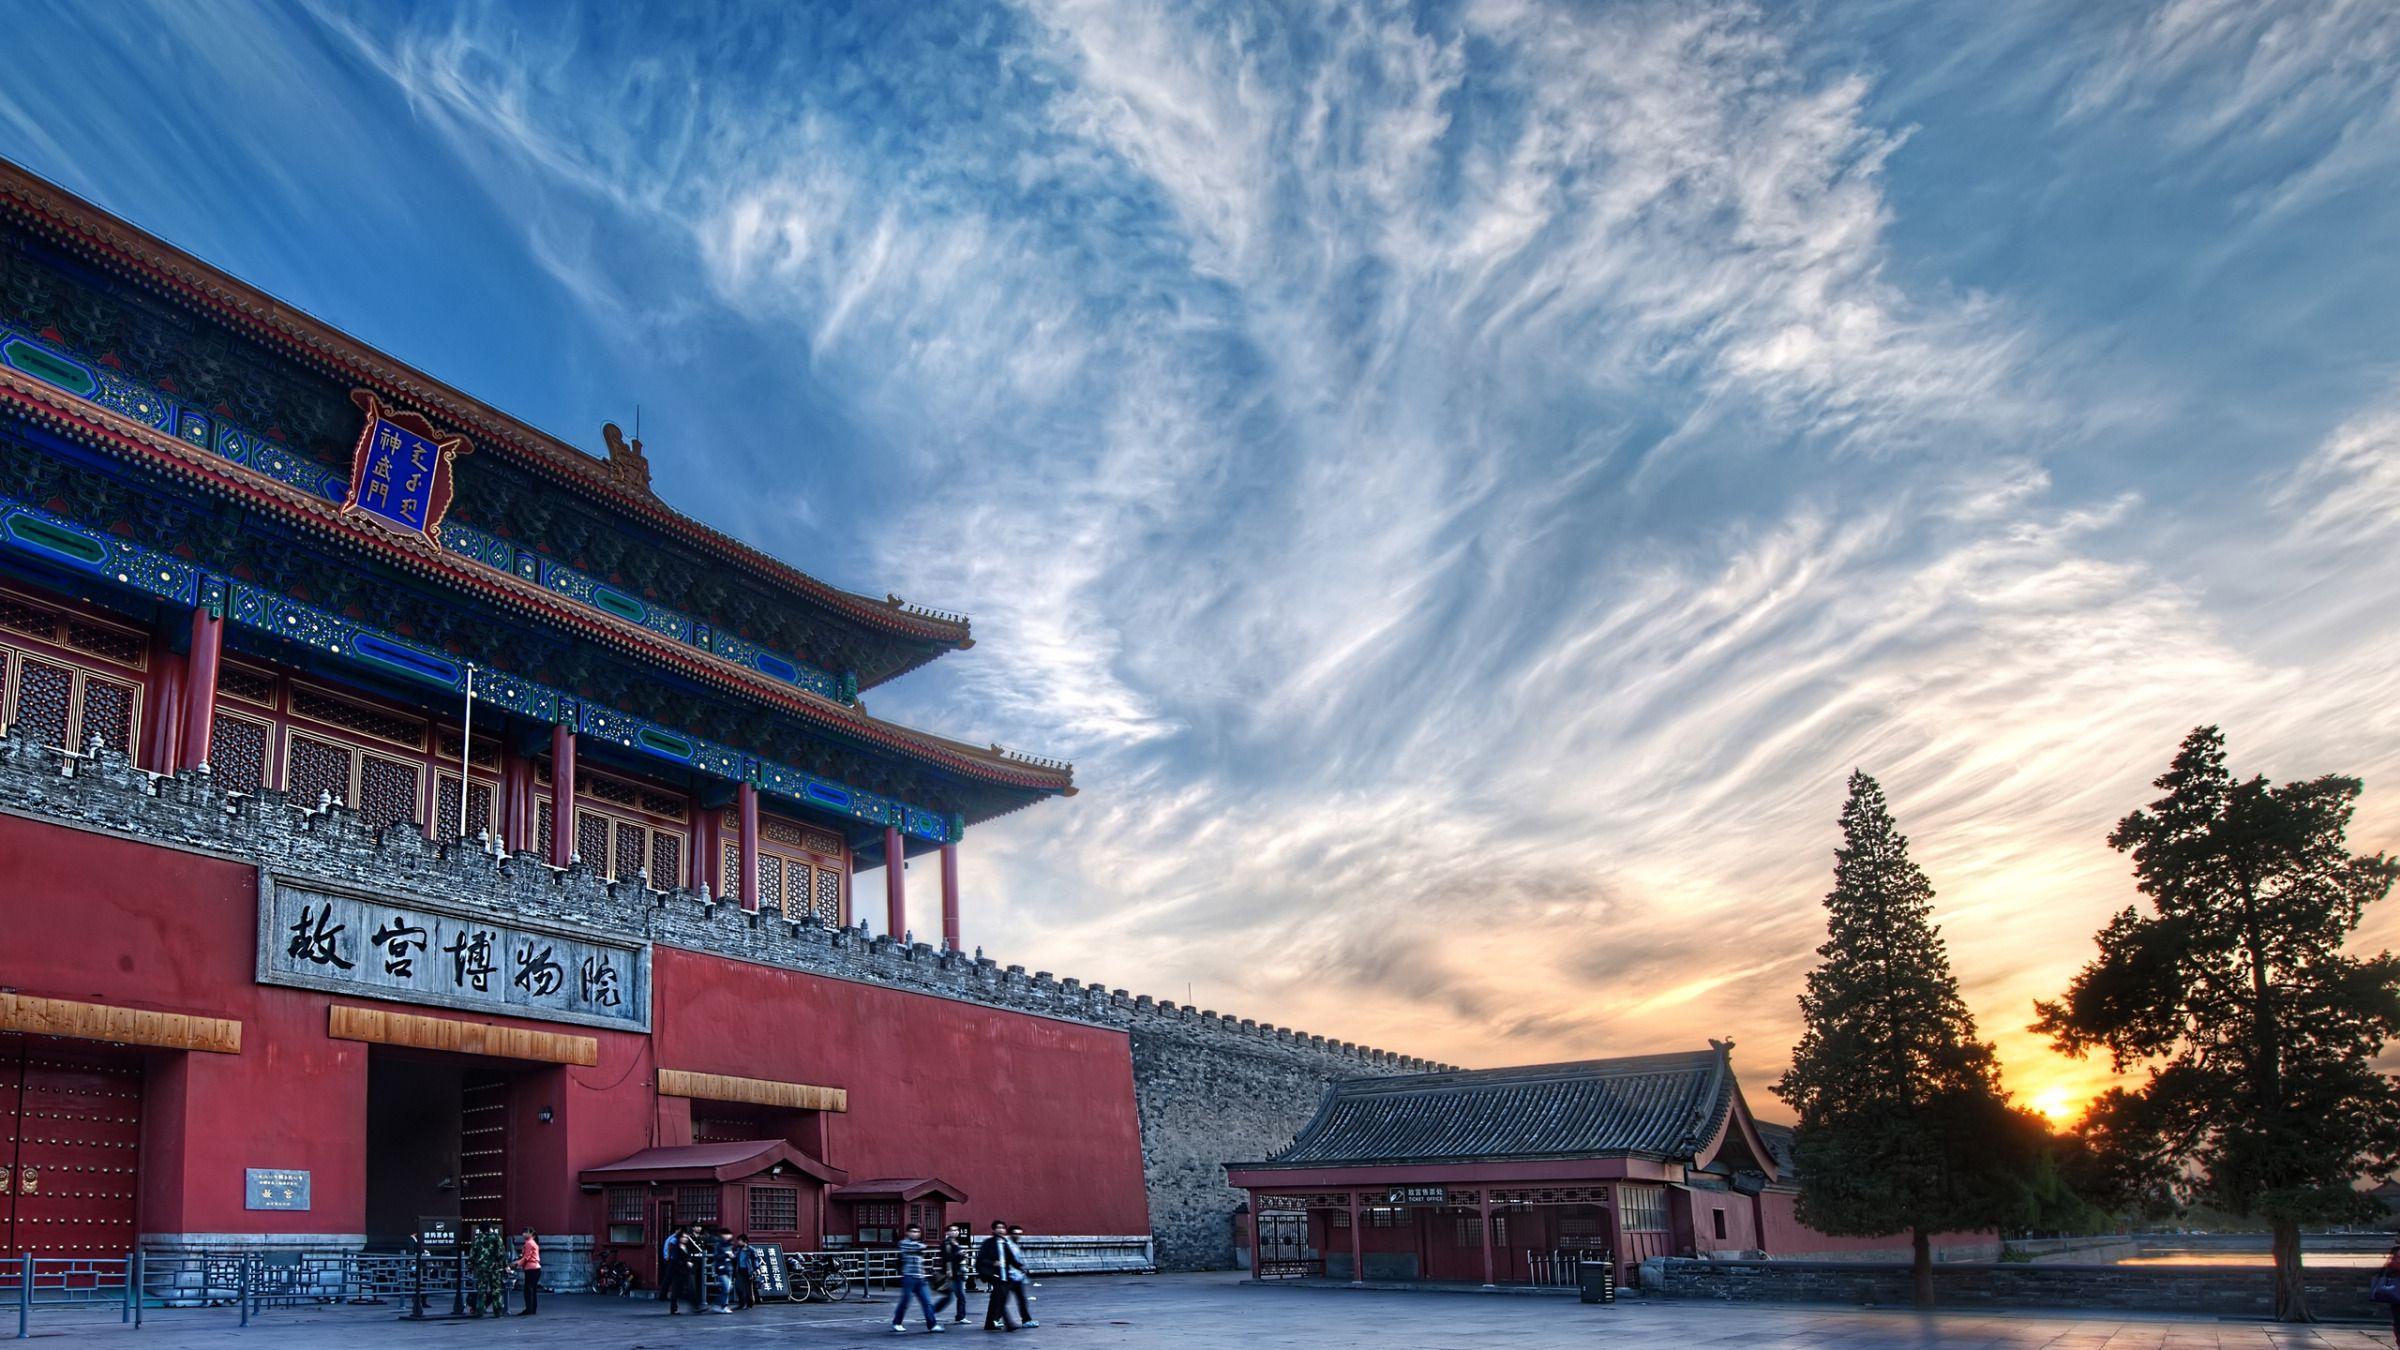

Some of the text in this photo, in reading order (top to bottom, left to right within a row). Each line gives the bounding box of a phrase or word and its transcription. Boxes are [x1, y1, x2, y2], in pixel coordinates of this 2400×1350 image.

[367, 428, 402, 508] 神武門
[287, 902, 622, 1008] 故宫博物院
